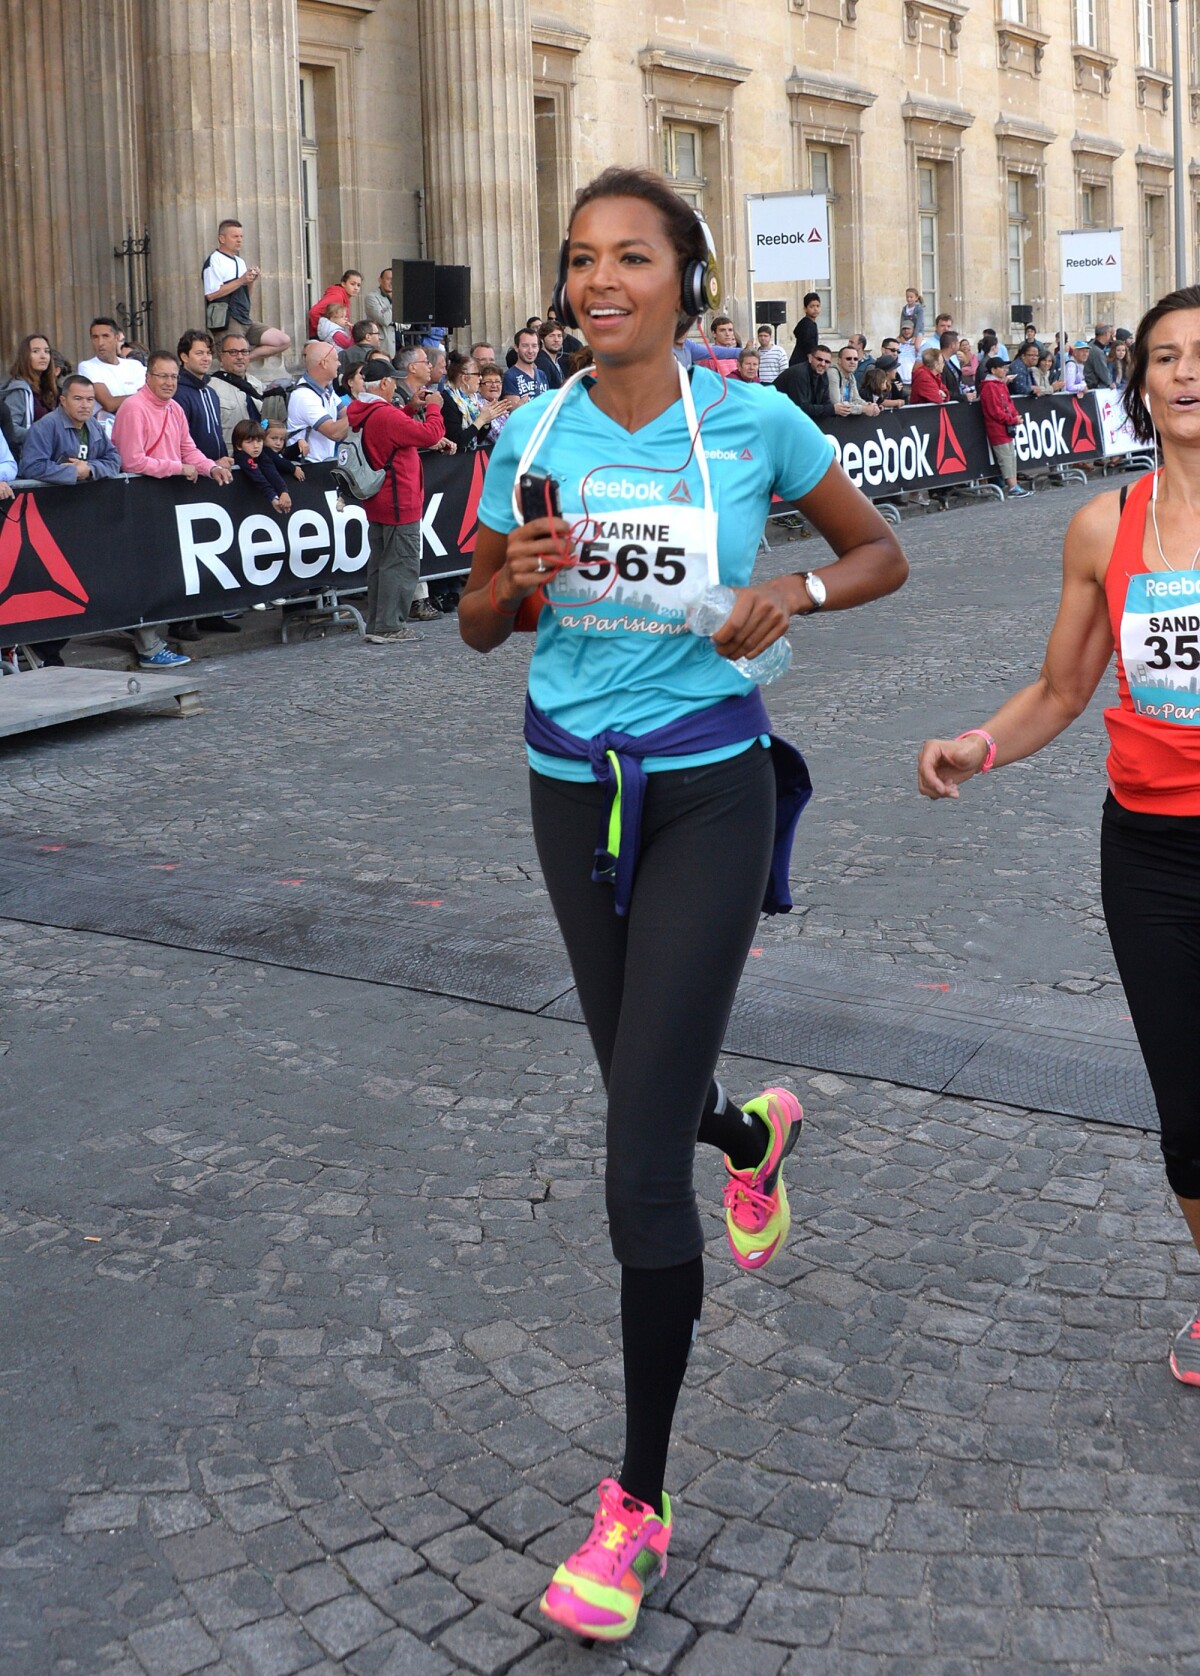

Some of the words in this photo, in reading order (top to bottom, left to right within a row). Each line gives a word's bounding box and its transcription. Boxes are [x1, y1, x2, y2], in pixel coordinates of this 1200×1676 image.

[756, 231, 805, 246] Reebok
[1065, 257, 1104, 268] Reebok
[986, 410, 1070, 466] ebok
[578, 477, 664, 501] Reebok
[174, 490, 448, 596] Reebk
[593, 521, 670, 543] KARINE
[577, 543, 686, 585] 565
[660, 606, 685, 617] 201
[1144, 634, 1200, 671] 35
[1137, 699, 1161, 717] La
